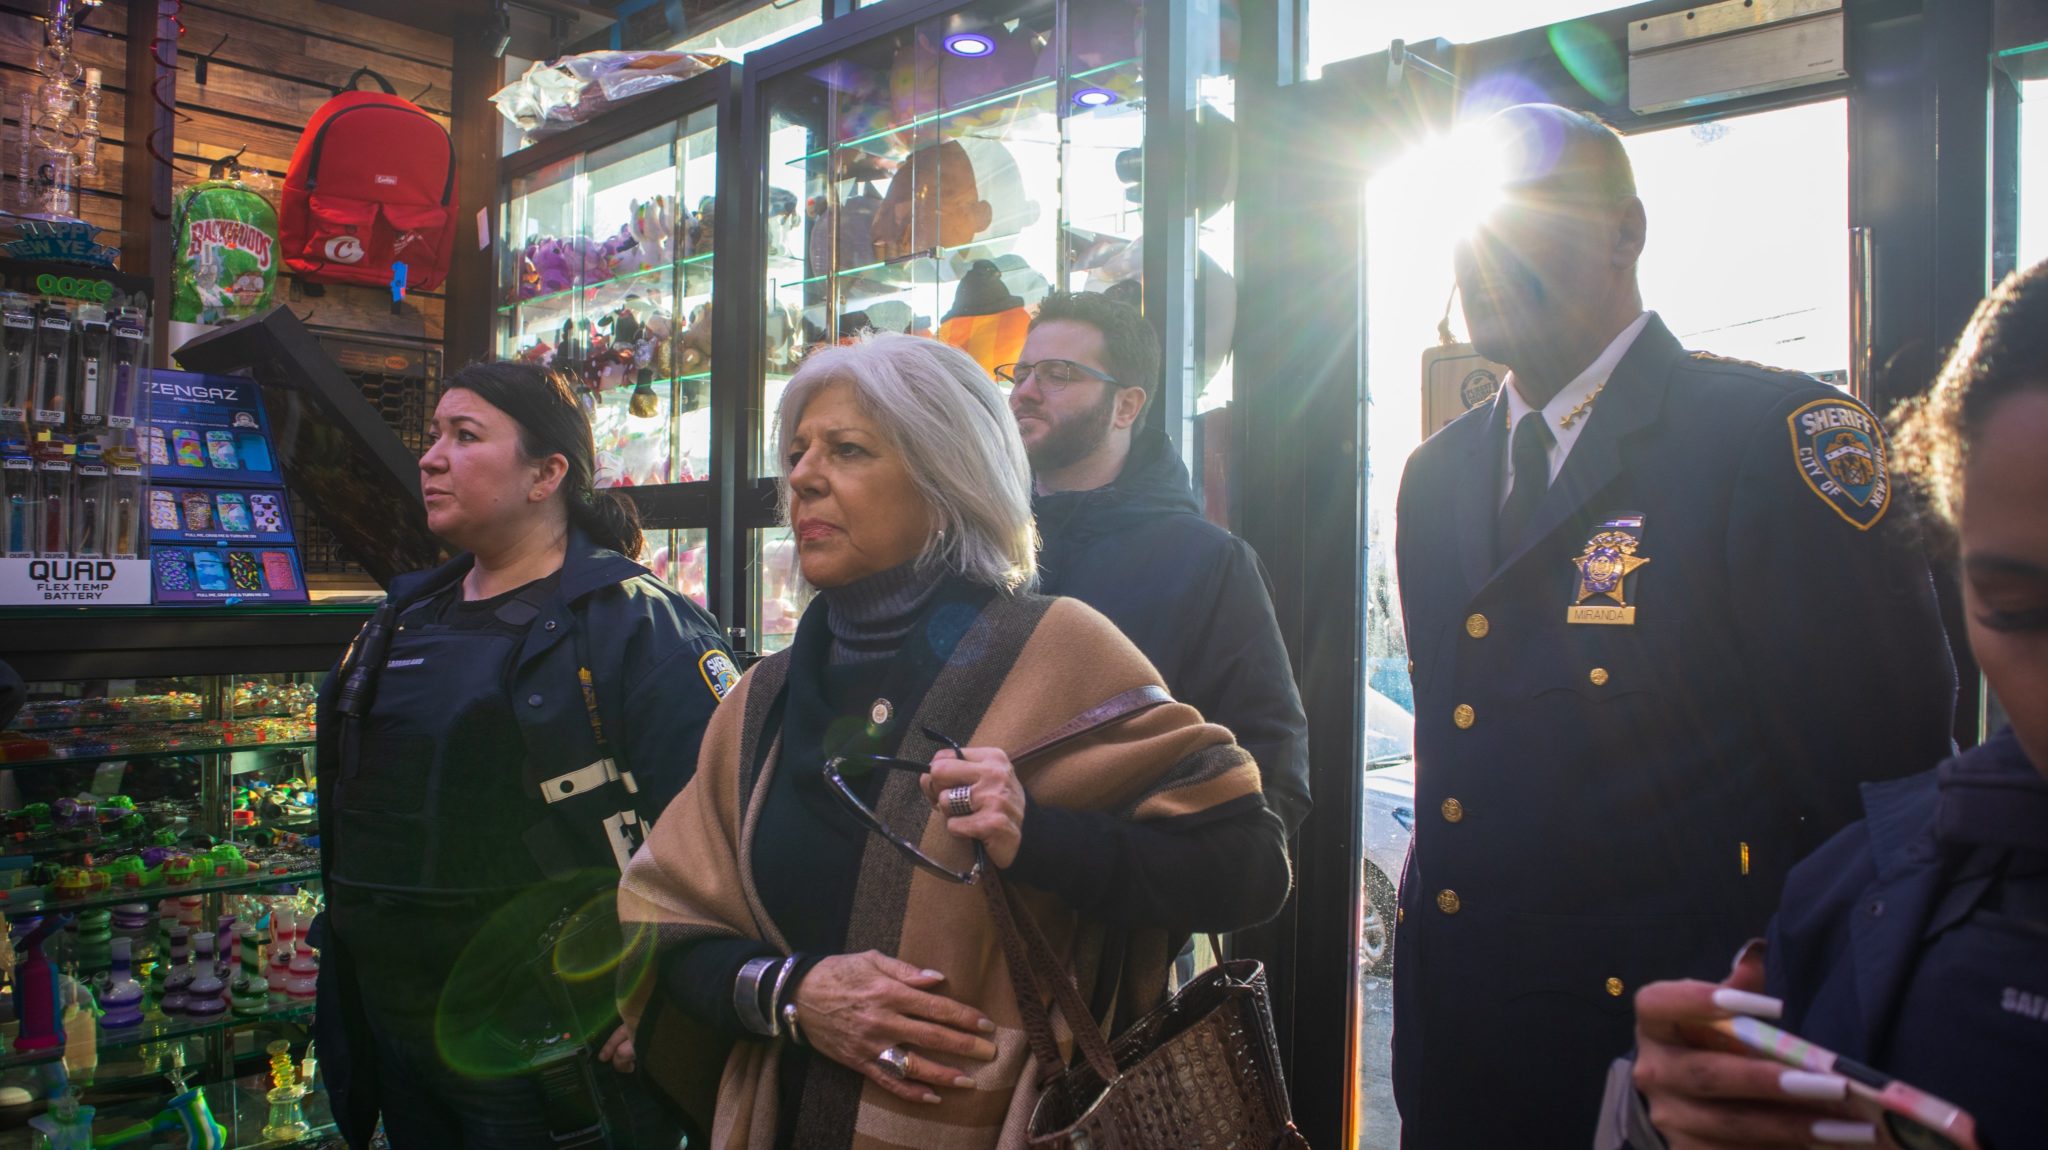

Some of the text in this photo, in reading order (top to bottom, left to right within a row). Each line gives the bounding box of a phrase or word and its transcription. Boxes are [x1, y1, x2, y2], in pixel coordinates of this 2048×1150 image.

[15, 222, 102, 241] HAPPY
[57, 240, 121, 262] YEAR
[187, 218, 273, 269] BACKWOODS
[142, 381, 239, 401] ZENGAZ
[1801, 407, 1872, 436] SHERIFF
[1800, 447, 1823, 476] CITY
[1820, 480, 1841, 496] OF
[1870, 479, 1887, 508] NEW
[29, 560, 116, 582] QUAD
[37, 583, 109, 591] FLEX TEMP
[44, 592, 103, 600] BATTERY
[1574, 609, 1625, 621] MIRANDA
